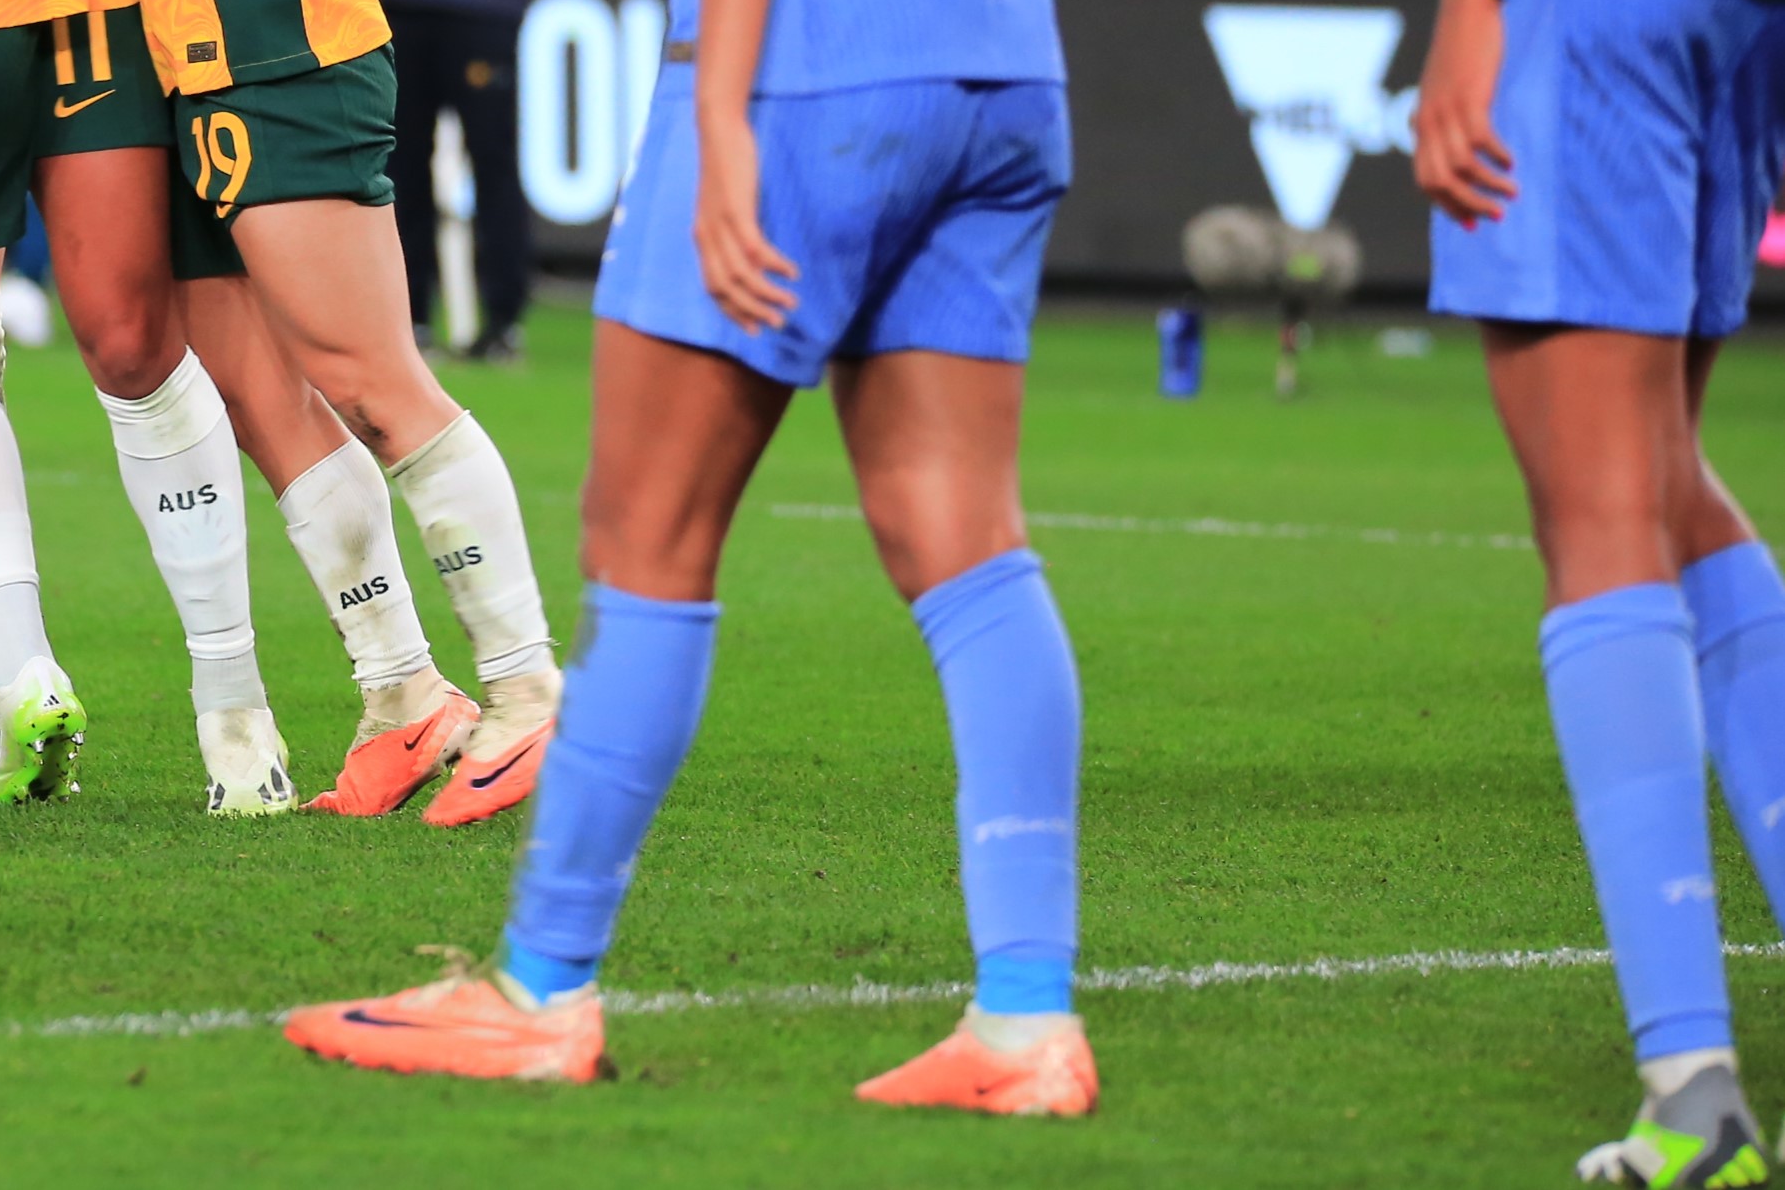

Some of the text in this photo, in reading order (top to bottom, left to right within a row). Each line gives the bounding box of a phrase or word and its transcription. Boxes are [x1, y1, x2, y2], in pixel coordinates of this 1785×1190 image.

[191, 111, 253, 201] 19
[159, 483, 218, 513] AUS
[432, 545, 483, 577] AUS
[340, 576, 390, 610] AUS
